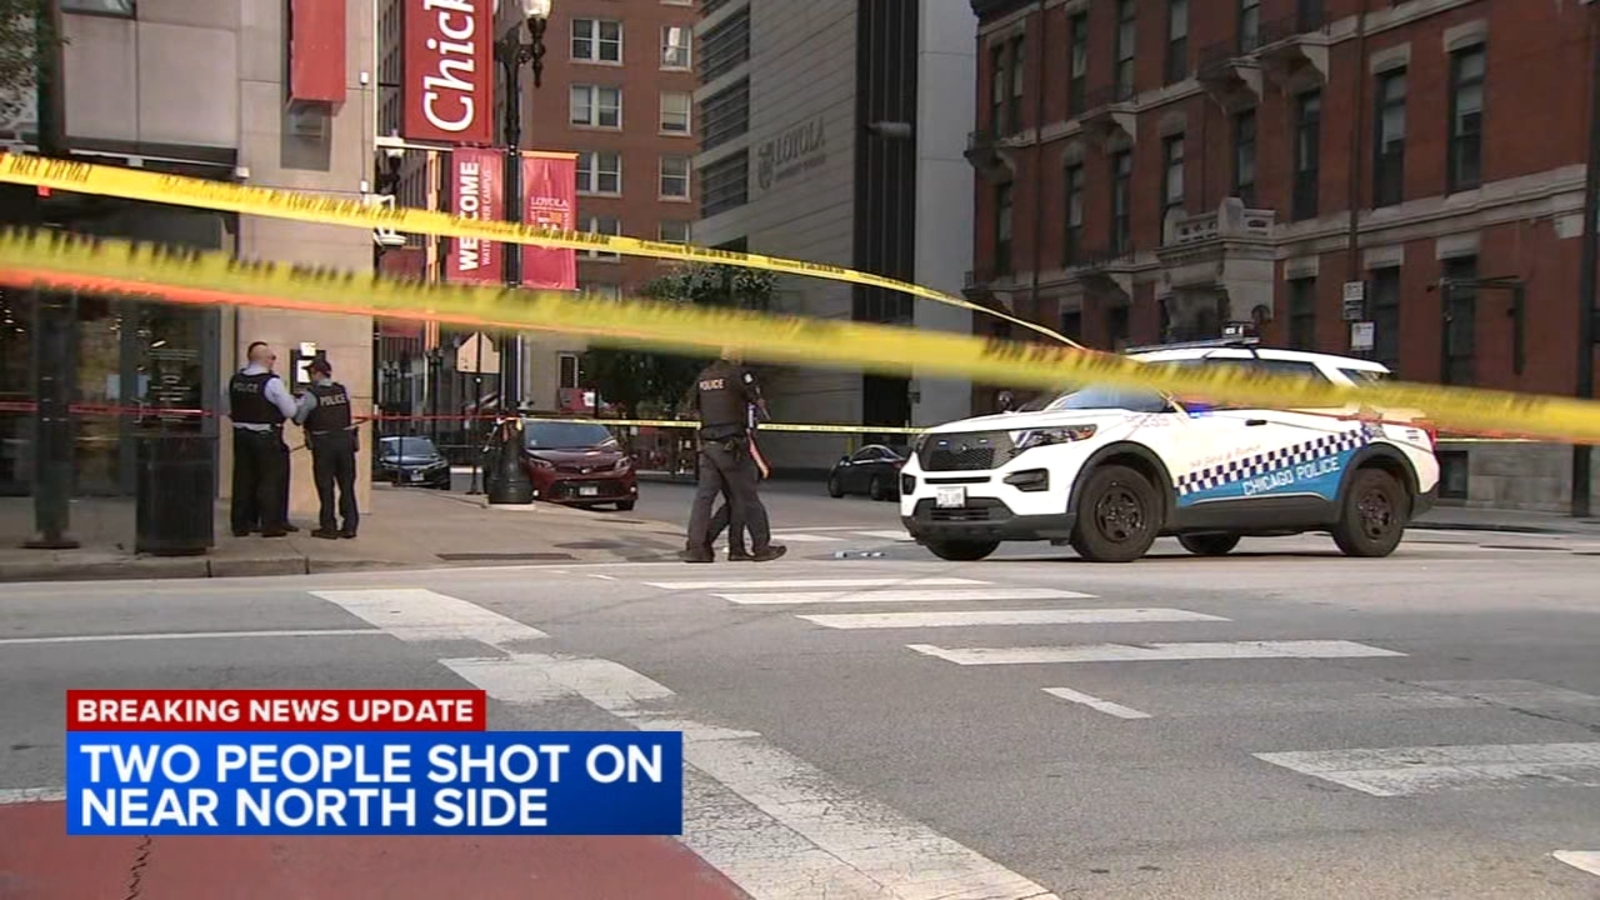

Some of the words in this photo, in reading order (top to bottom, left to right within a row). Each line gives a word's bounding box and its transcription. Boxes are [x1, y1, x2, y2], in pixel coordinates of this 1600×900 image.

[531, 196, 569, 208] LOYOLA
[459, 161, 479, 271] WECOME
[232, 382, 258, 393] POLICE
[700, 379, 724, 390] POLICE
[320, 393, 347, 406] POLICE
[1242, 469, 1295, 496] CHICAGO
[1296, 457, 1341, 480] POLICE
